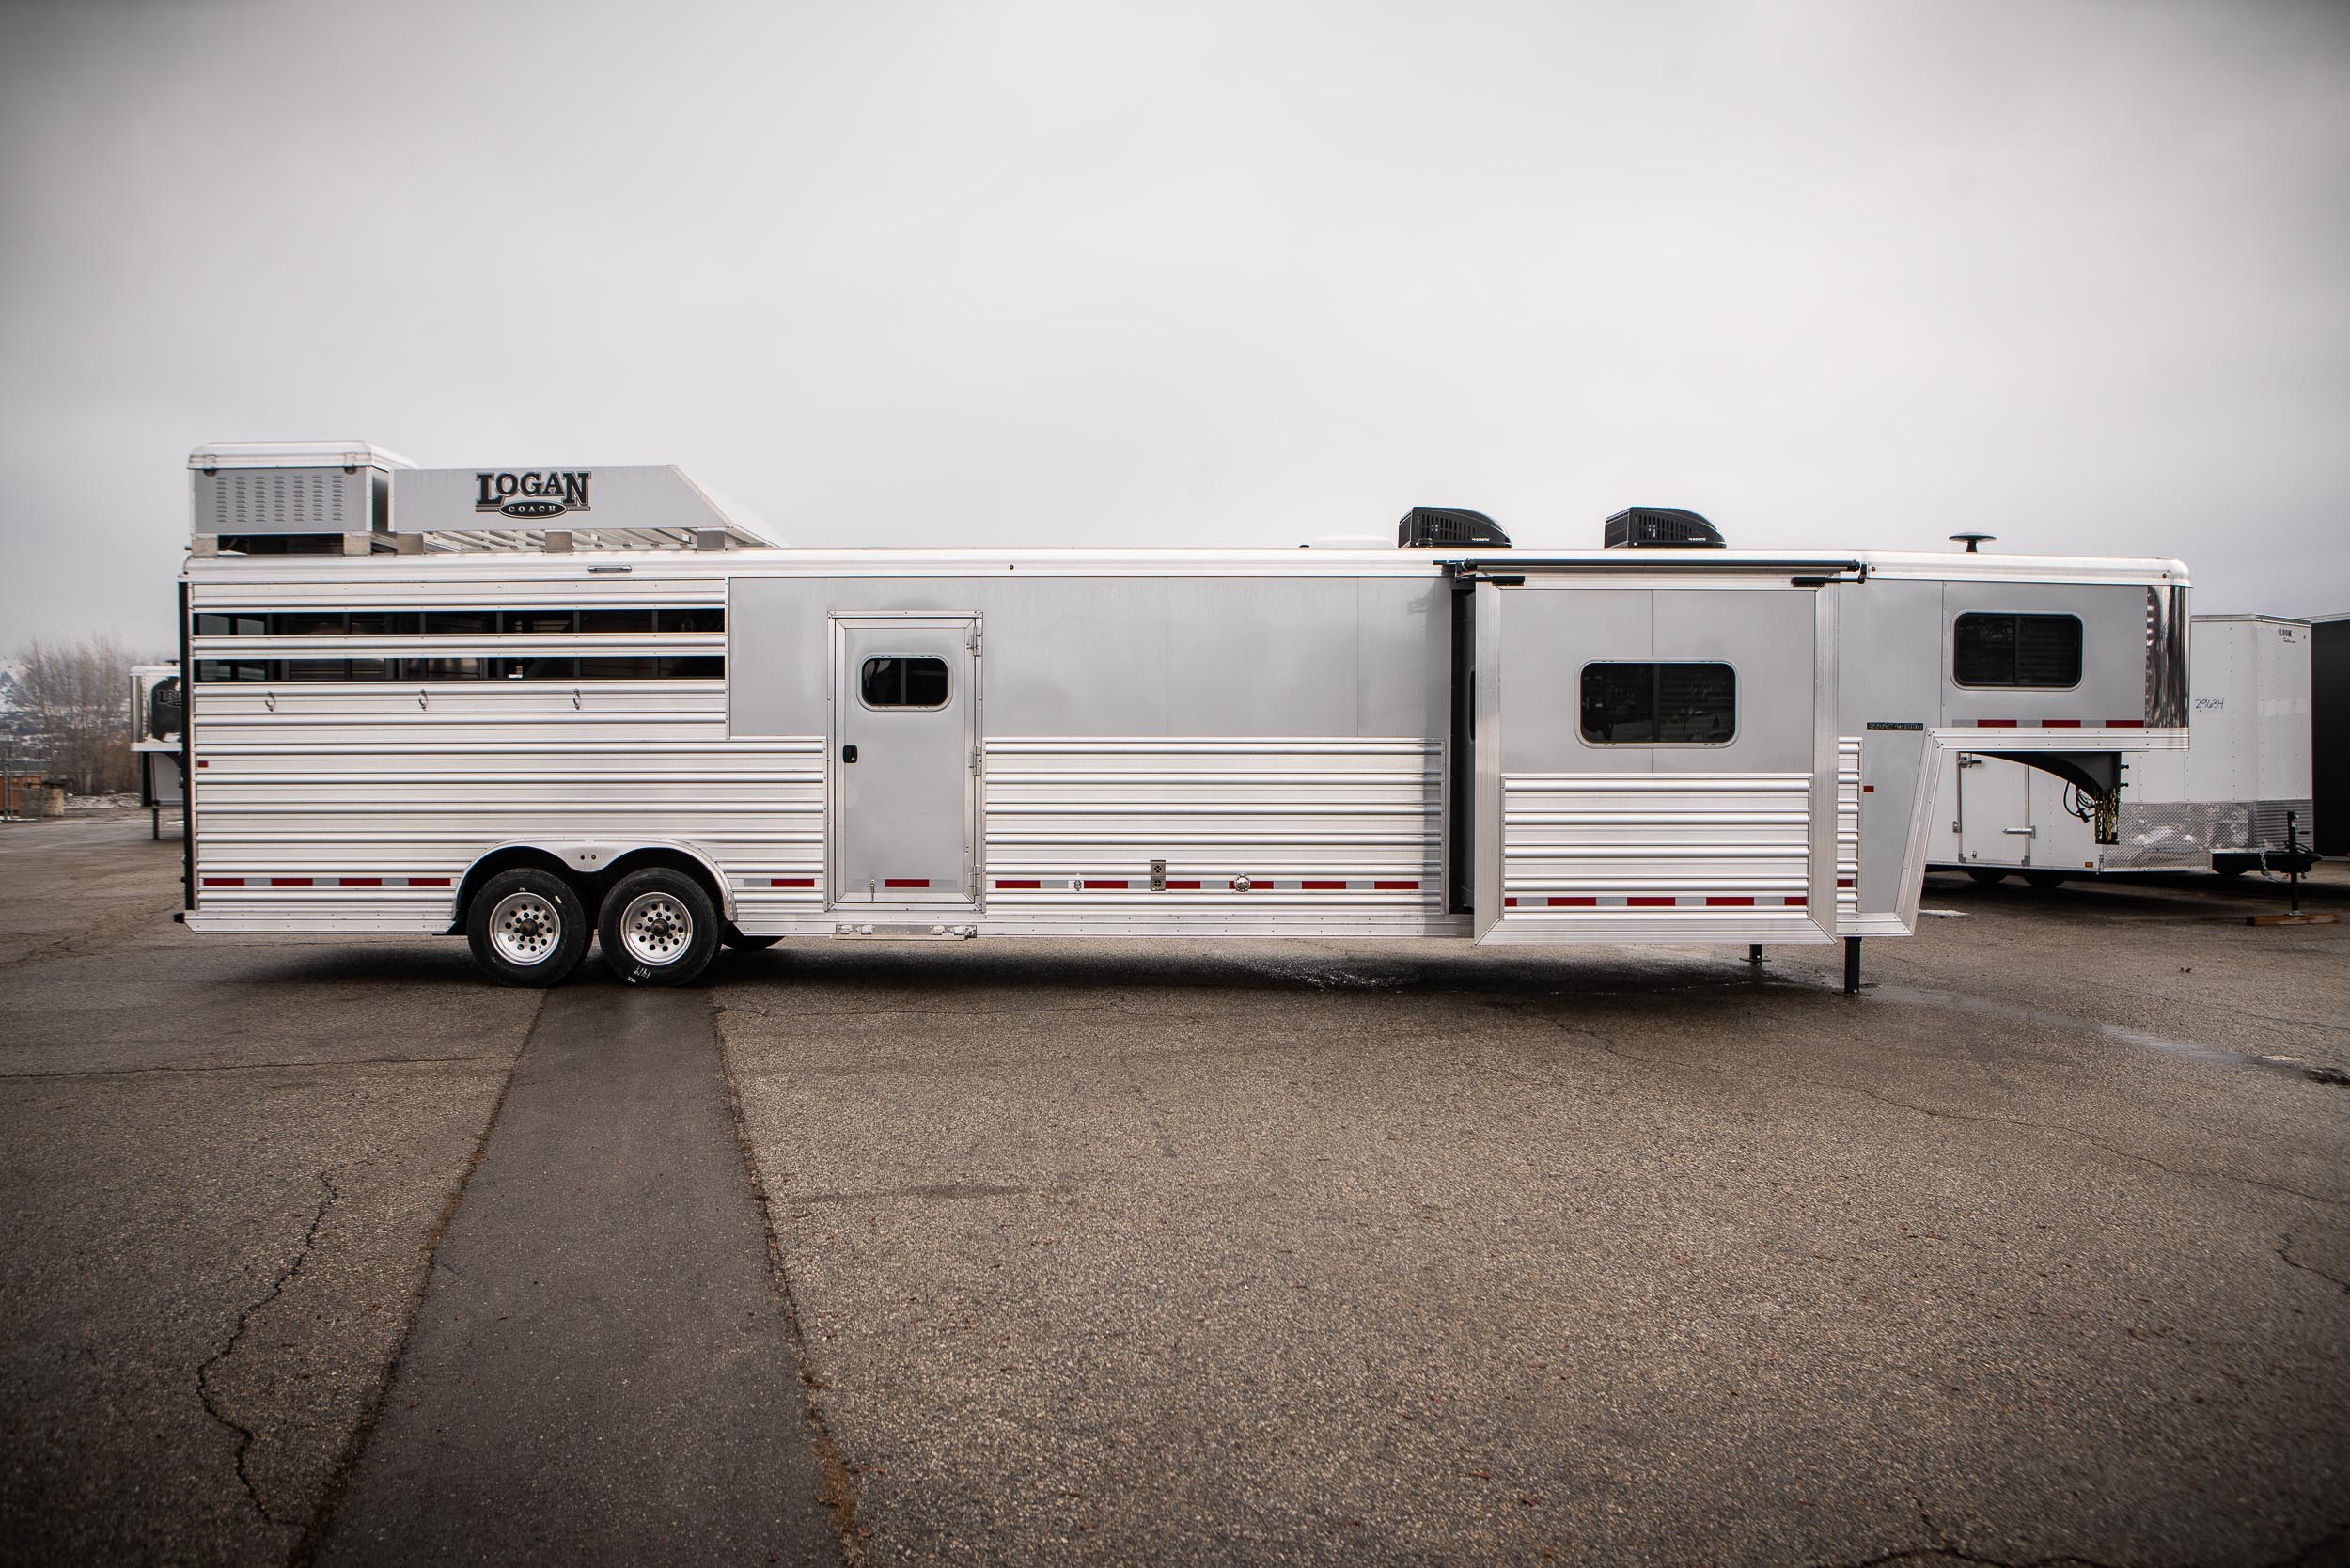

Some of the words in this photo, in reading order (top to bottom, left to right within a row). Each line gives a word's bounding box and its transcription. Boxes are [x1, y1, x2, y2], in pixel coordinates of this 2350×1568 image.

[475, 471, 591, 506] LOGAN
[508, 505, 556, 513] COACH
[2195, 698, 2224, 710] 29634
